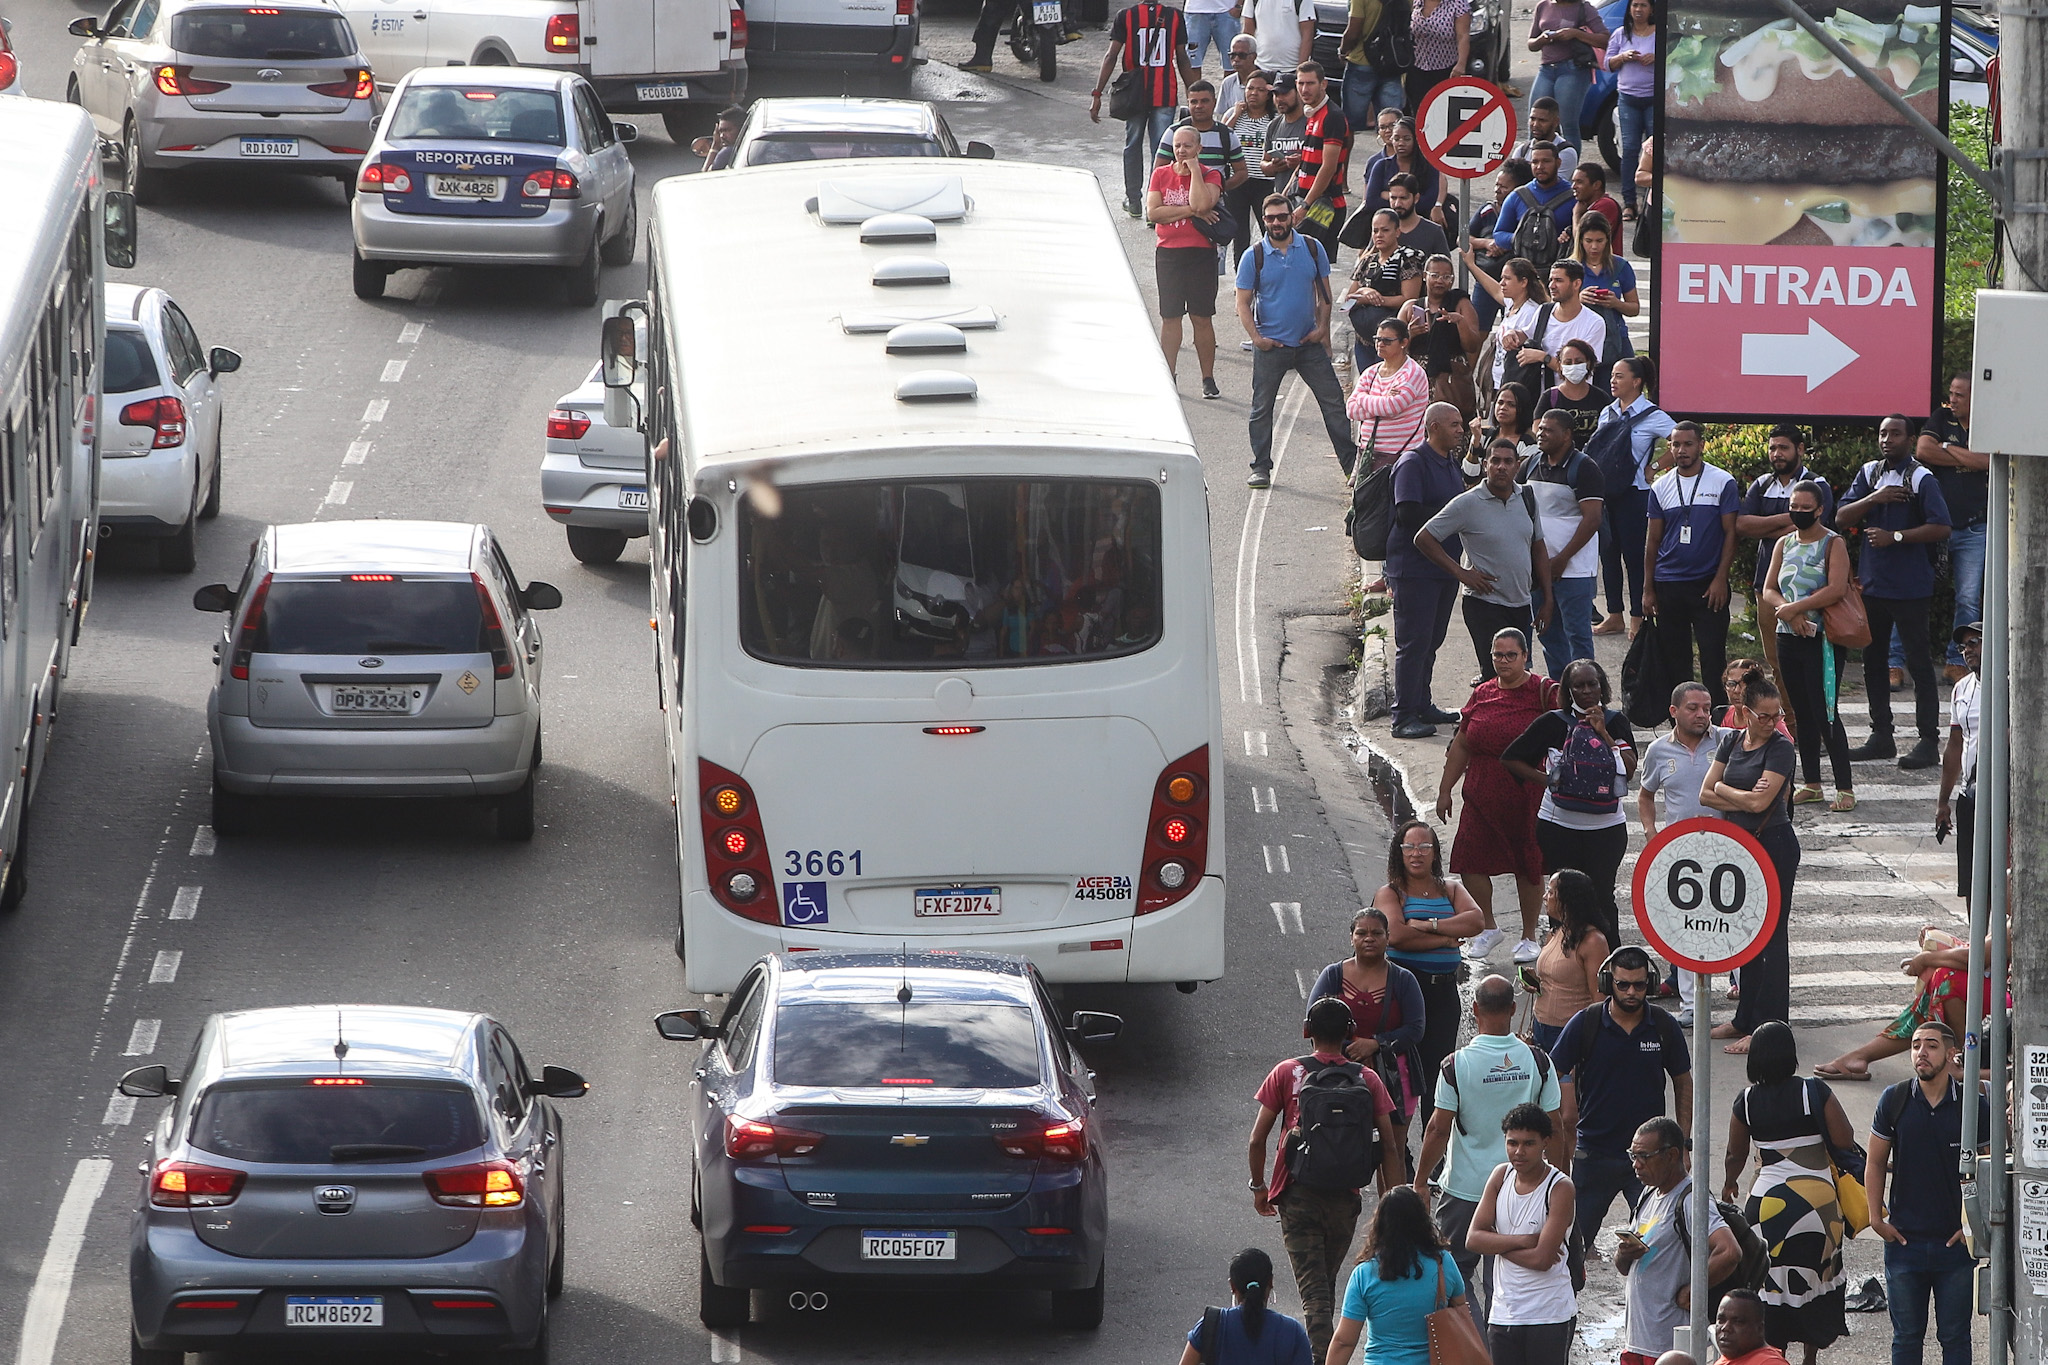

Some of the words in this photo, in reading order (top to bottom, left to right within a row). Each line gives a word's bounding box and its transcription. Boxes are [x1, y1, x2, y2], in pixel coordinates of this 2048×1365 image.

[381, 18, 405, 31] ESTAF
[1446, 95, 1485, 159] E
[1271, 139, 1305, 151] TOMMY
[415, 151, 515, 166] REPORTAGEM
[1677, 263, 1918, 307] ENTRADA
[1666, 758, 1677, 774] 3
[784, 849, 862, 877] 3661
[1076, 875, 1132, 888] AGERBA
[1667, 858, 1747, 914] 60
[1074, 887, 1132, 901] 445081
[923, 896, 992, 913] FXF2D74
[1684, 914, 1730, 934] km/h
[2030, 1052, 2048, 1064] 32
[324, 1189, 346, 1199] KIA
[806, 1192, 836, 1200] ONIX
[869, 1239, 946, 1257] RCQ5F07
